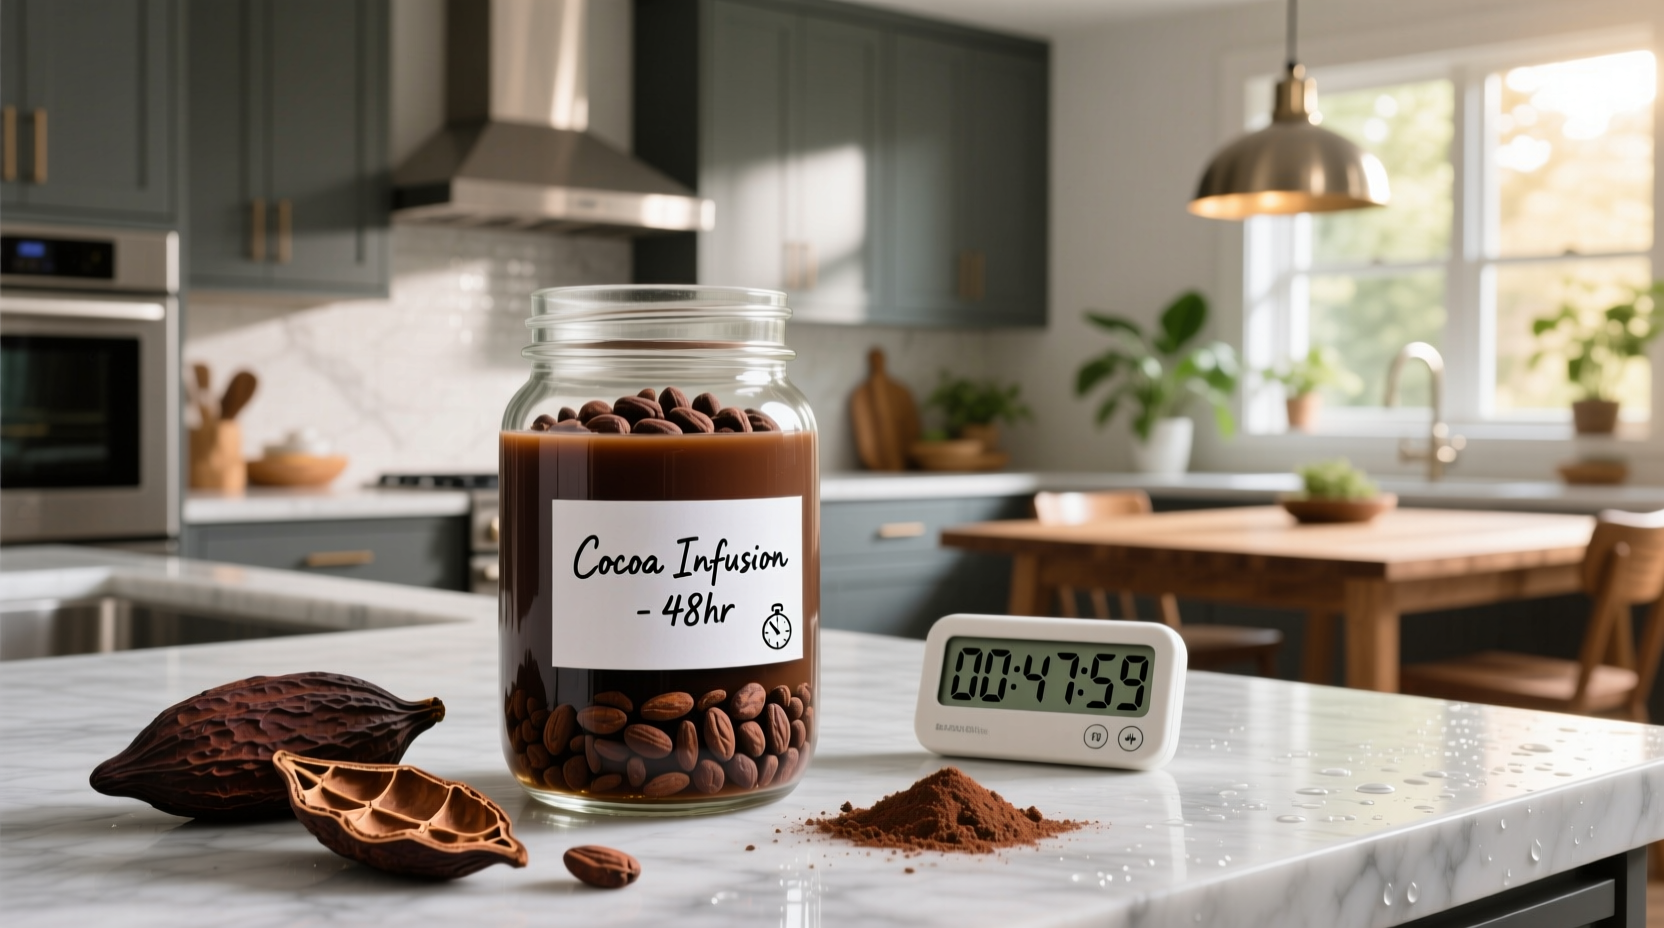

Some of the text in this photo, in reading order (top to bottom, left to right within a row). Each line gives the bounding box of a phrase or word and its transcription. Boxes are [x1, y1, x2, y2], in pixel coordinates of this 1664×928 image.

[573, 534, 789, 587] Cocoa Infusion
[661, 591, 736, 627] 48hr
[950, 646, 1150, 711] 00:47:59
